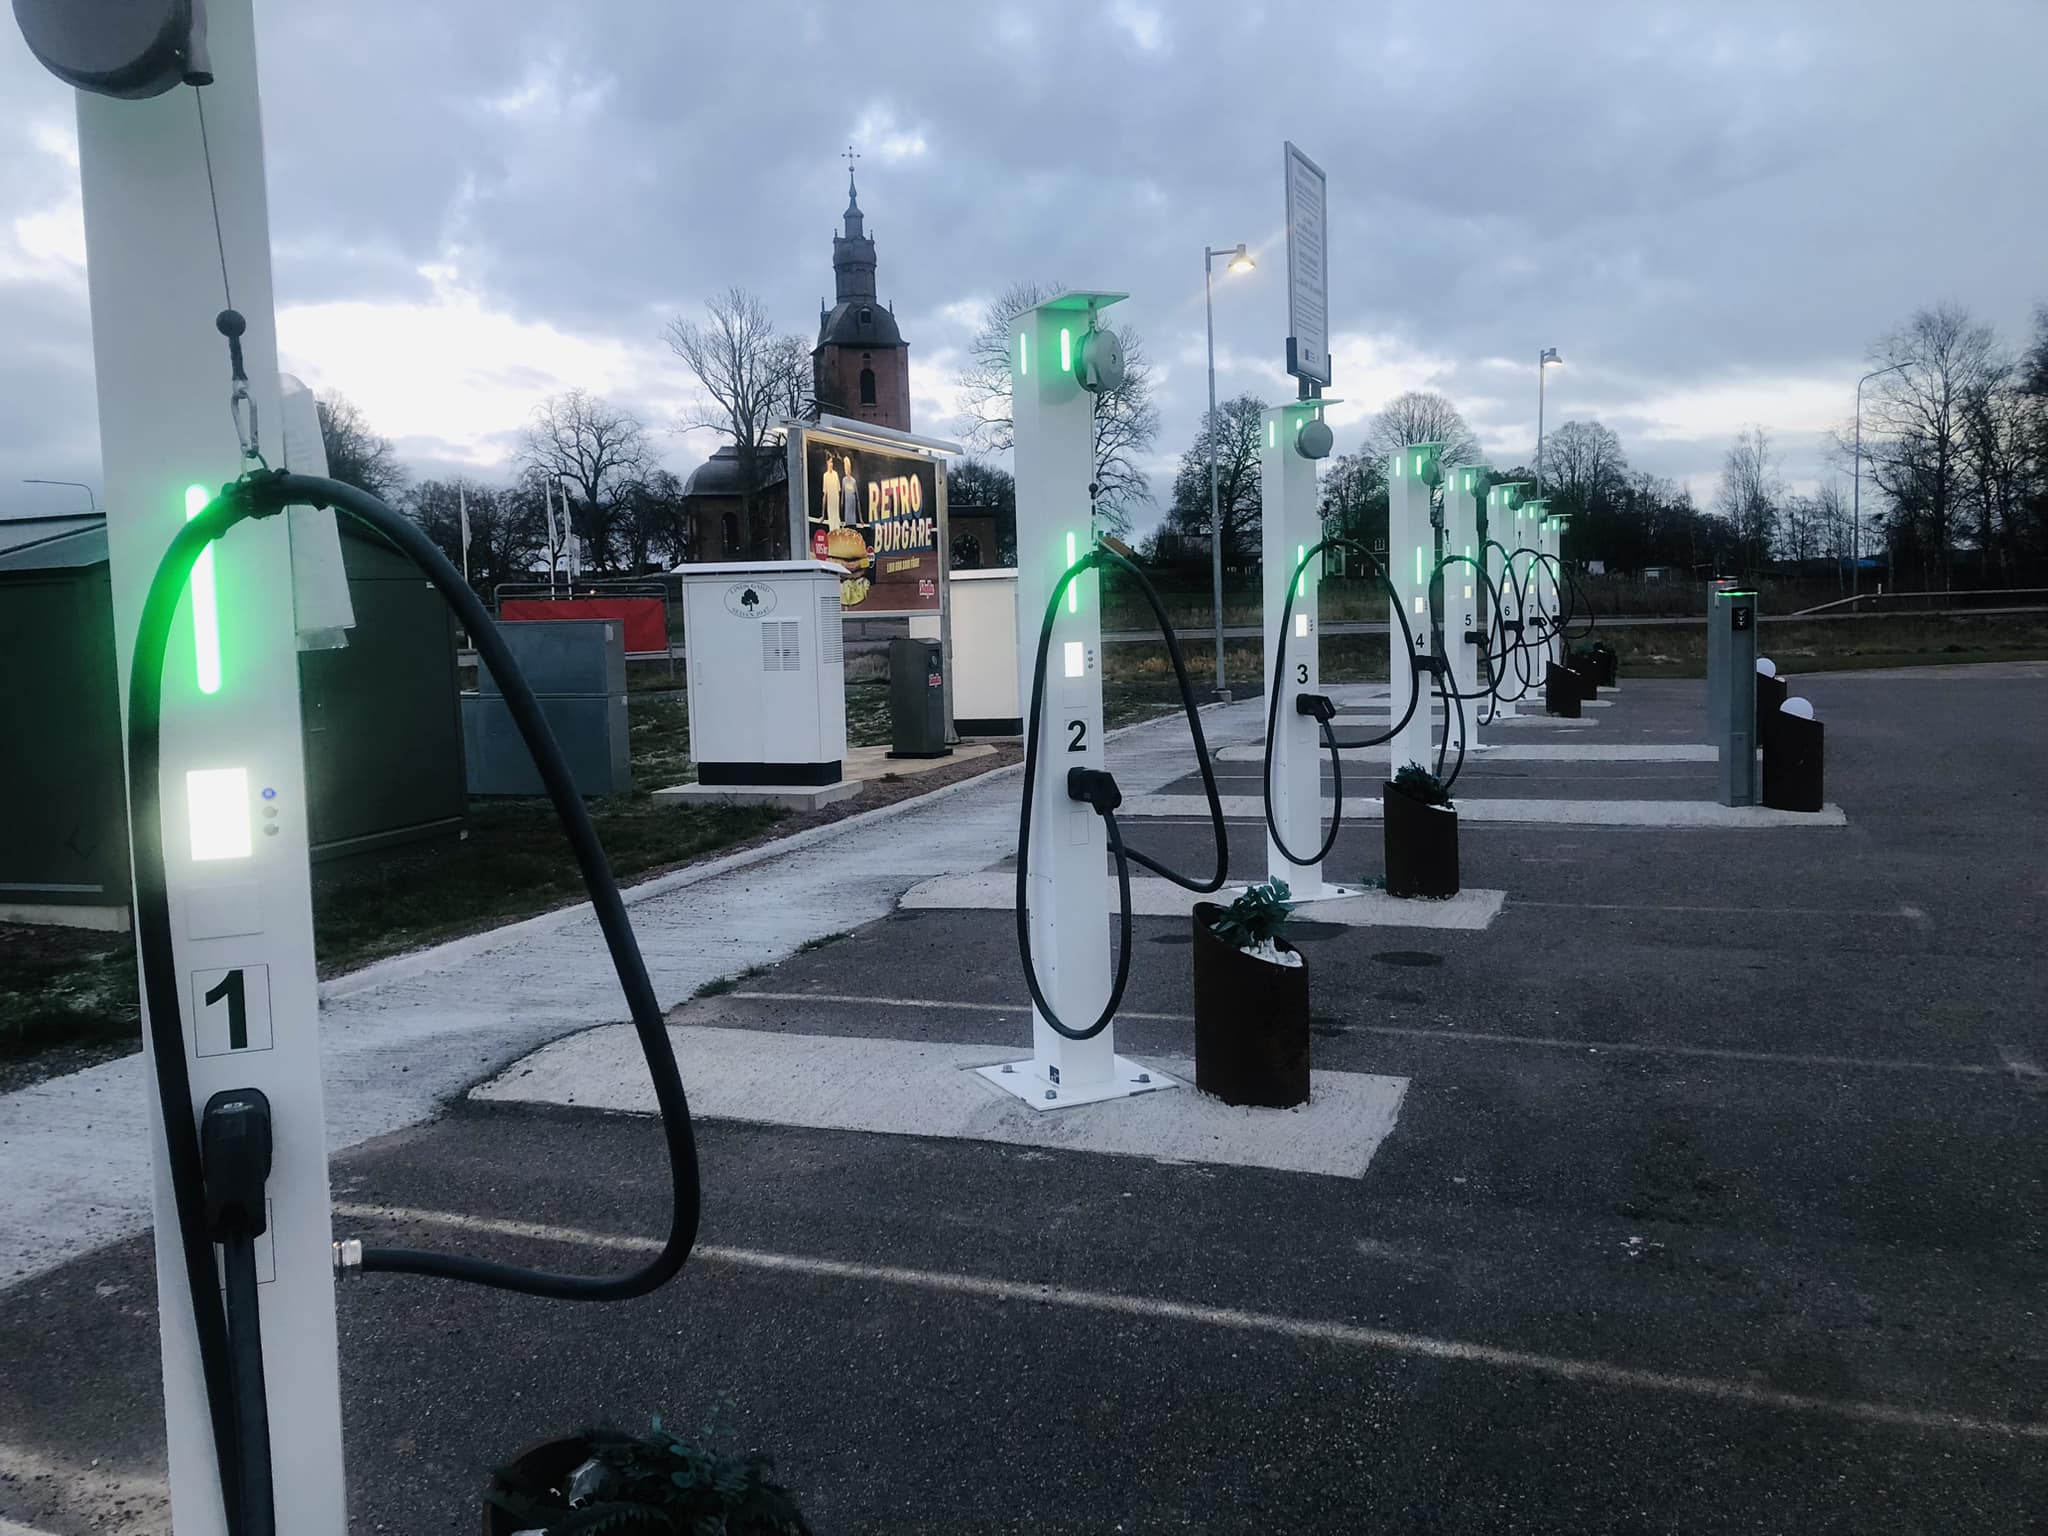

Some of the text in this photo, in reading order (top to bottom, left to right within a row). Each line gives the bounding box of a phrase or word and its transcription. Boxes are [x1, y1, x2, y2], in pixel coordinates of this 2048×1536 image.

[868, 473, 922, 522] RETRO
[874, 517, 933, 553] BURGARE
[1504, 606, 1510, 616] 6
[1529, 604, 1534, 613] 7
[1552, 605, 1557, 613] 8
[1465, 614, 1472, 626] 5
[1415, 633, 1425, 648] 4
[1297, 664, 1308, 684] 3
[1067, 720, 1087, 752] 2
[205, 969, 248, 1050] 1
